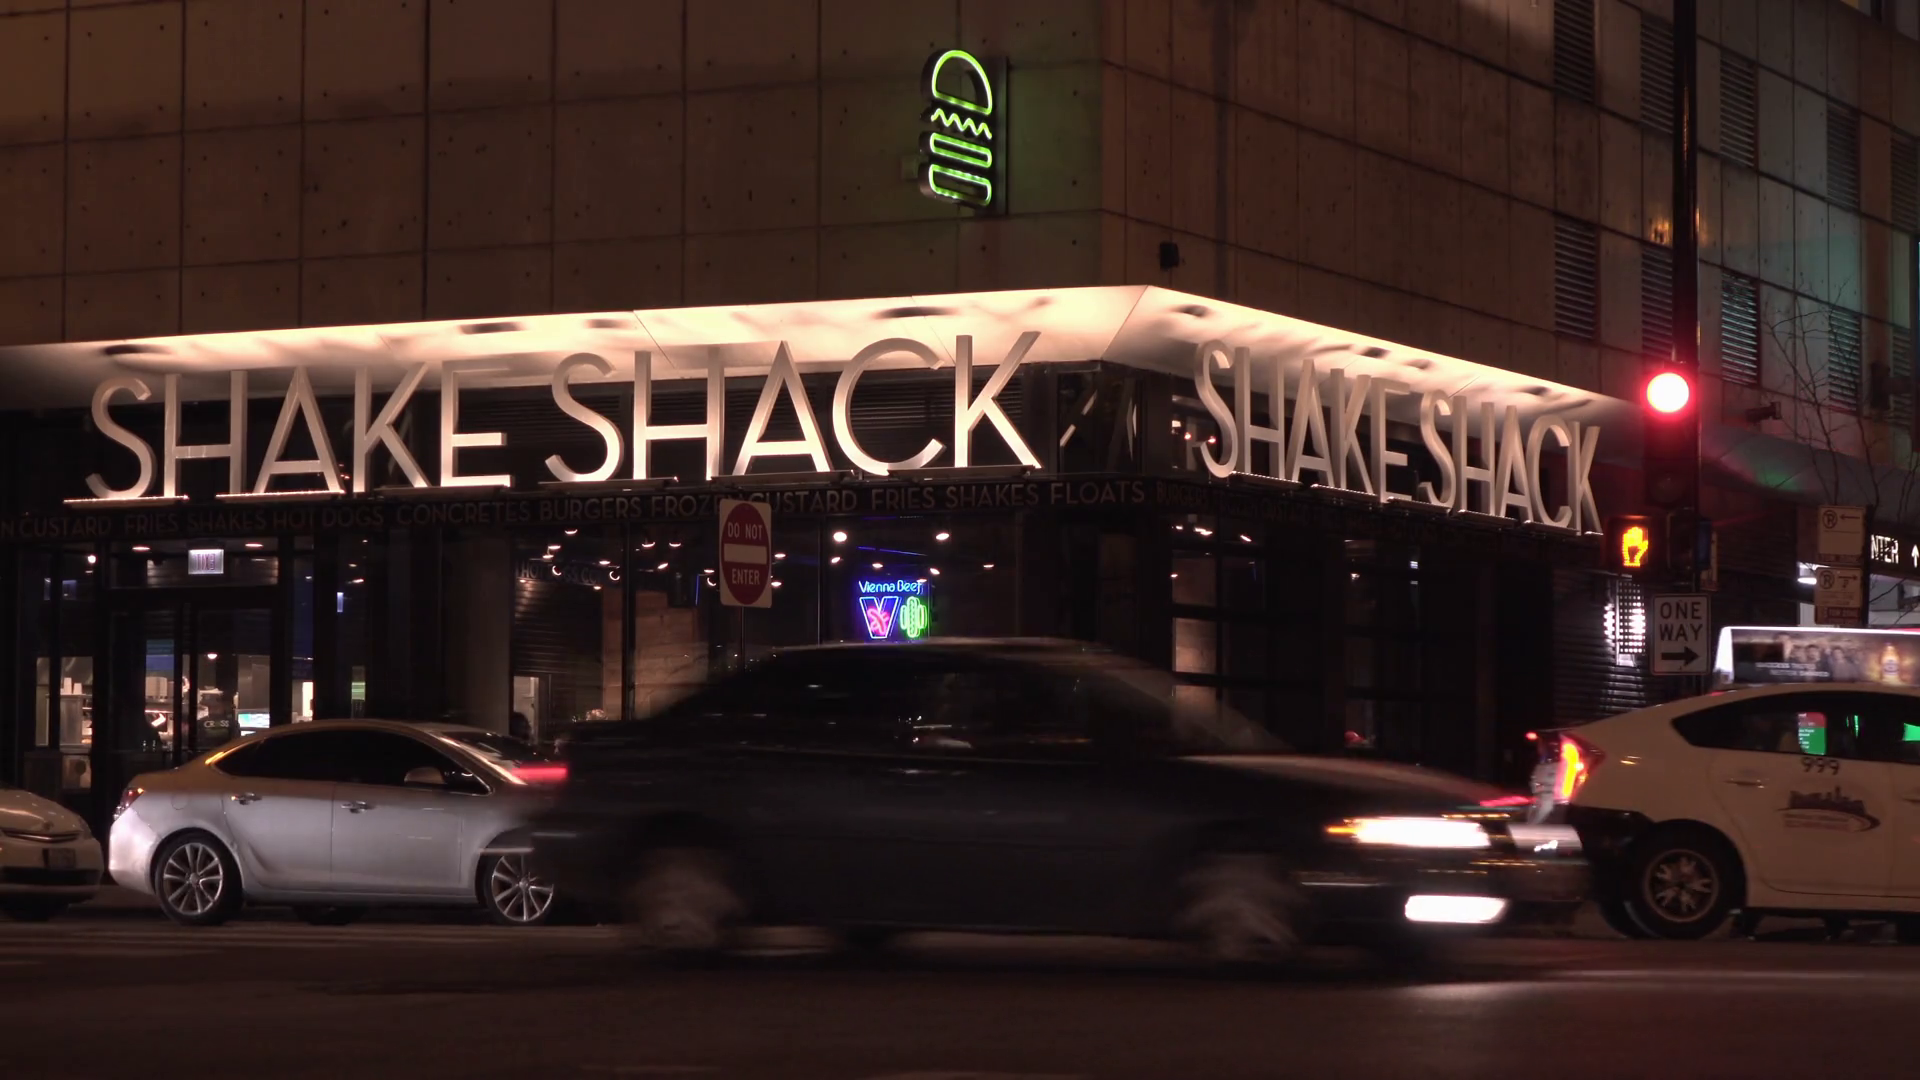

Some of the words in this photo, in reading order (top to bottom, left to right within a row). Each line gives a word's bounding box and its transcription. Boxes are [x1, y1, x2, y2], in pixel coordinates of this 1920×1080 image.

[85, 360, 515, 500] SHAKE
[545, 331, 1043, 482] SHACK
[1194, 339, 1411, 503] SHAKE
[1418, 388, 1604, 537] SHACK
[19, 515, 112, 538] CUSTARD
[124, 512, 179, 534] FRIES
[187, 506, 267, 532] SHAKES
[273, 508, 315, 530] HOT
[321, 505, 385, 528] DOGS
[396, 500, 531, 525] CONCRETES
[540, 496, 643, 521] BURGERS
[872, 486, 936, 511] FRIES
[945, 483, 1039, 509] SHAKES
[1049, 480, 1146, 505] FLOATS
[727, 521, 740, 539] DO
[745, 523, 763, 541] NOT
[731, 568, 761, 586] ENTER
[858, 580, 896, 594] Vienna
[897, 579, 923, 595] Beef
[1660, 601, 1702, 620] ONE
[1659, 623, 1703, 641] WAY
[1801, 756, 1839, 776] 999
